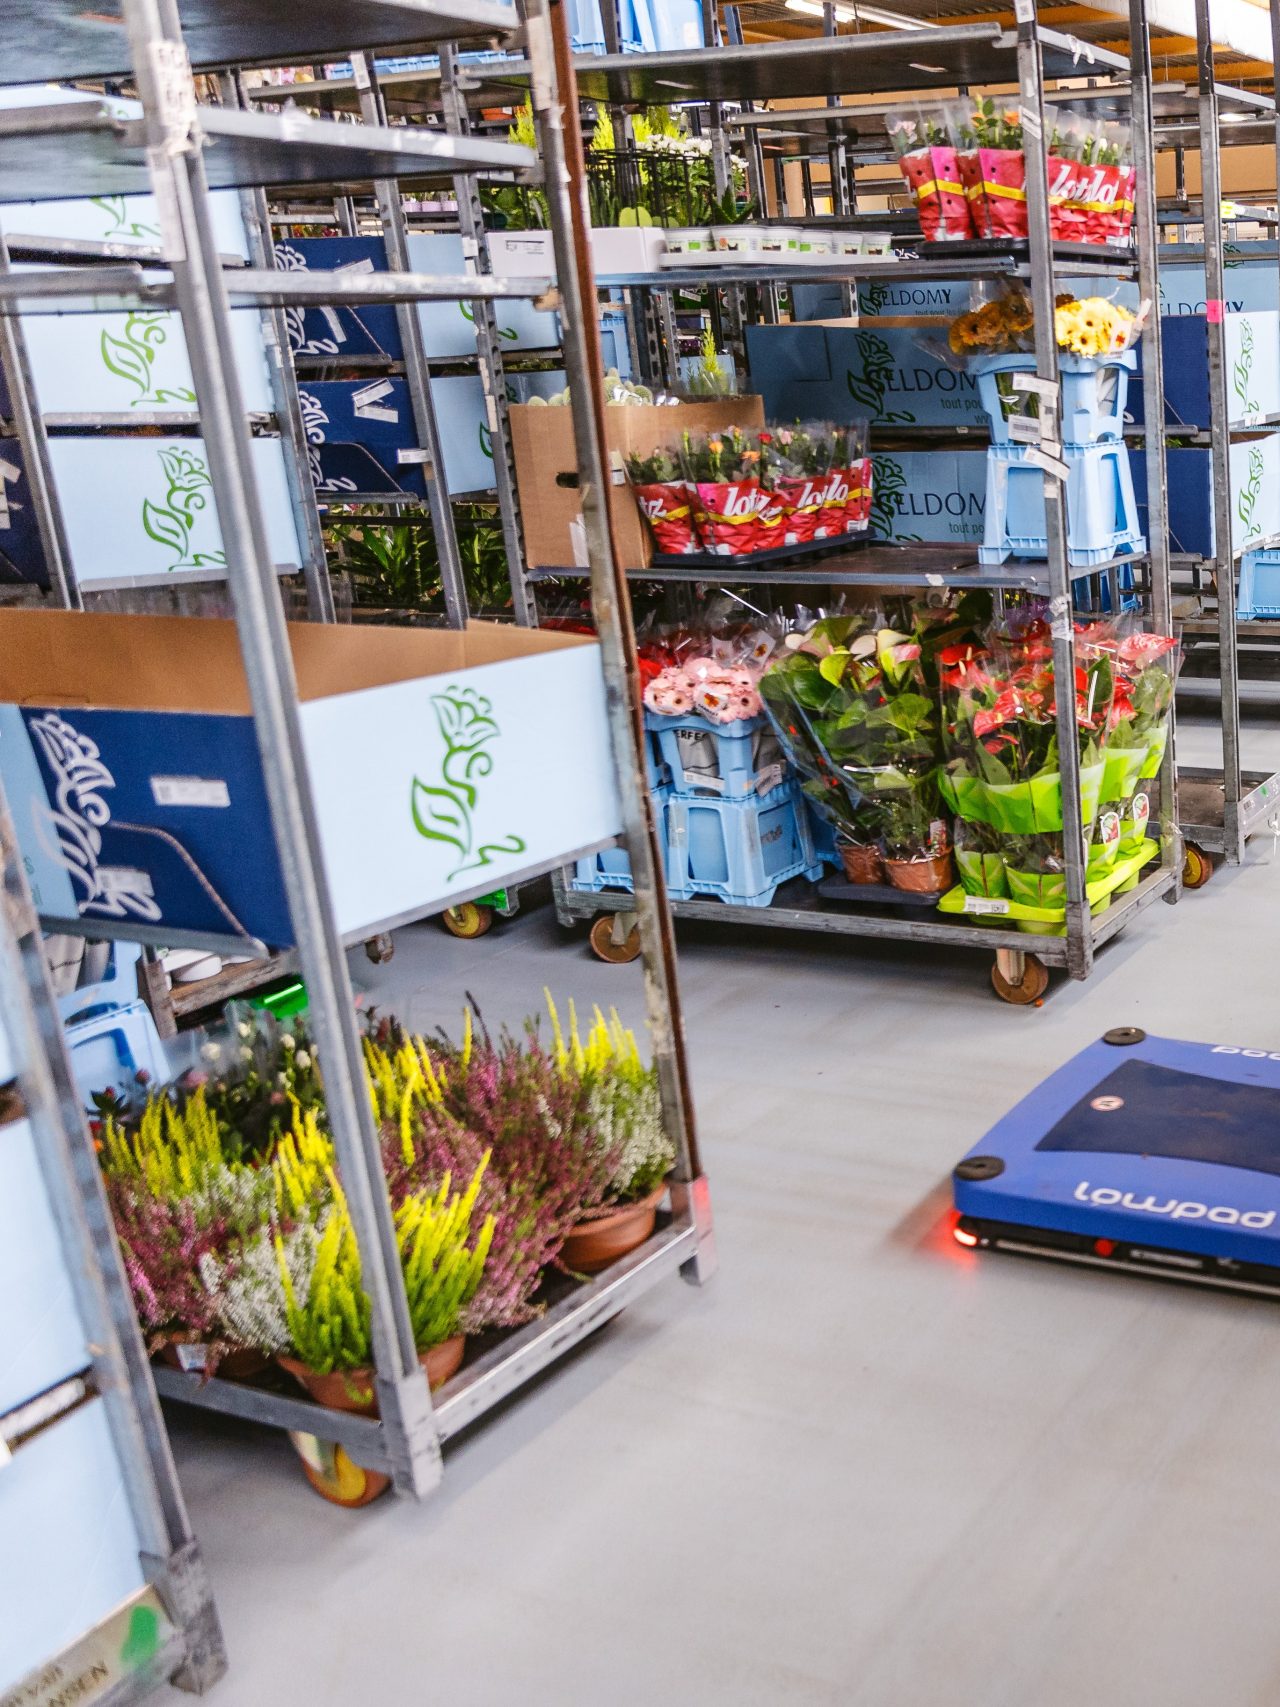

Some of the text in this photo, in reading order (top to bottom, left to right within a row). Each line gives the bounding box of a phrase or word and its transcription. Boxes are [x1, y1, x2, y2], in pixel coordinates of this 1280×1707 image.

[941, 399, 961, 410] tout
[948, 521, 969, 534] tout
[1073, 1180, 1278, 1229] lowpad
